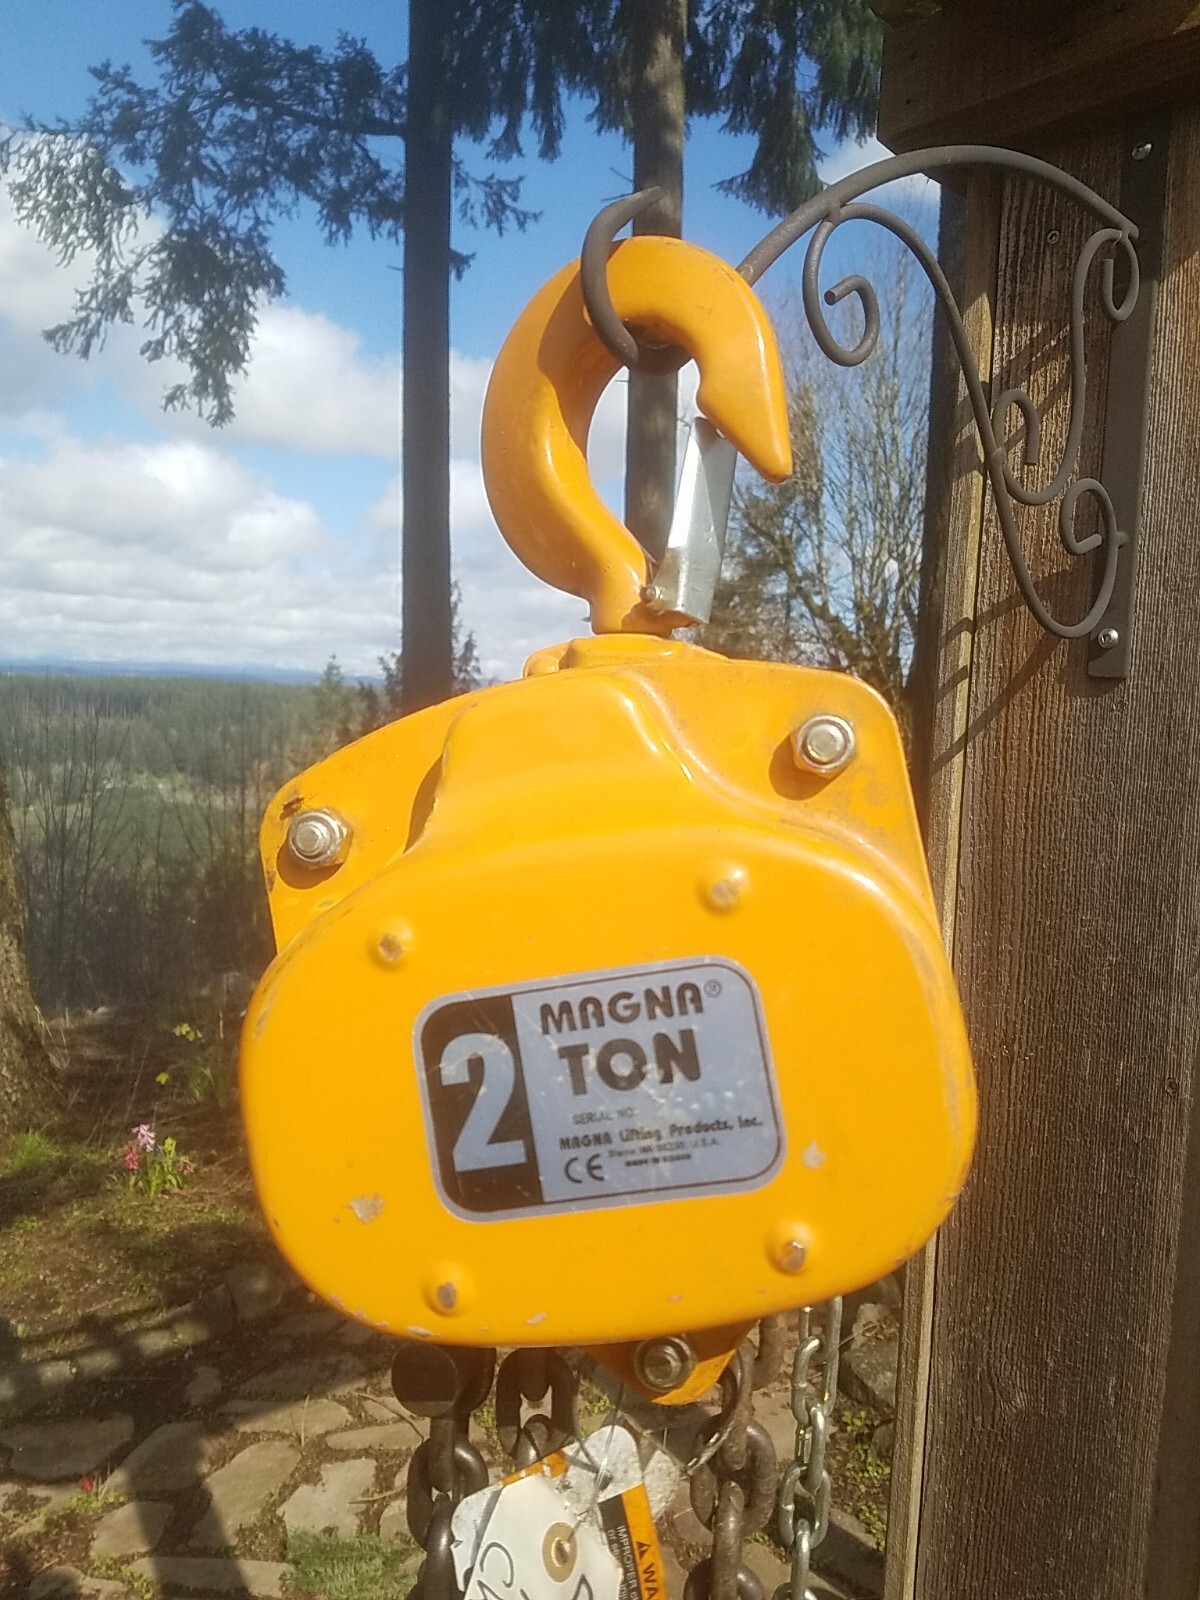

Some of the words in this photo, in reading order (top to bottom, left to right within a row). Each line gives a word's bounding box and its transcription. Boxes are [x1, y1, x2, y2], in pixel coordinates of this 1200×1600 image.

[557, 1028, 701, 1097] TON
[440, 1032, 527, 1173] 2
[559, 1131, 613, 1151] MAGNA
[616, 1524, 638, 1590] IMPROPER
